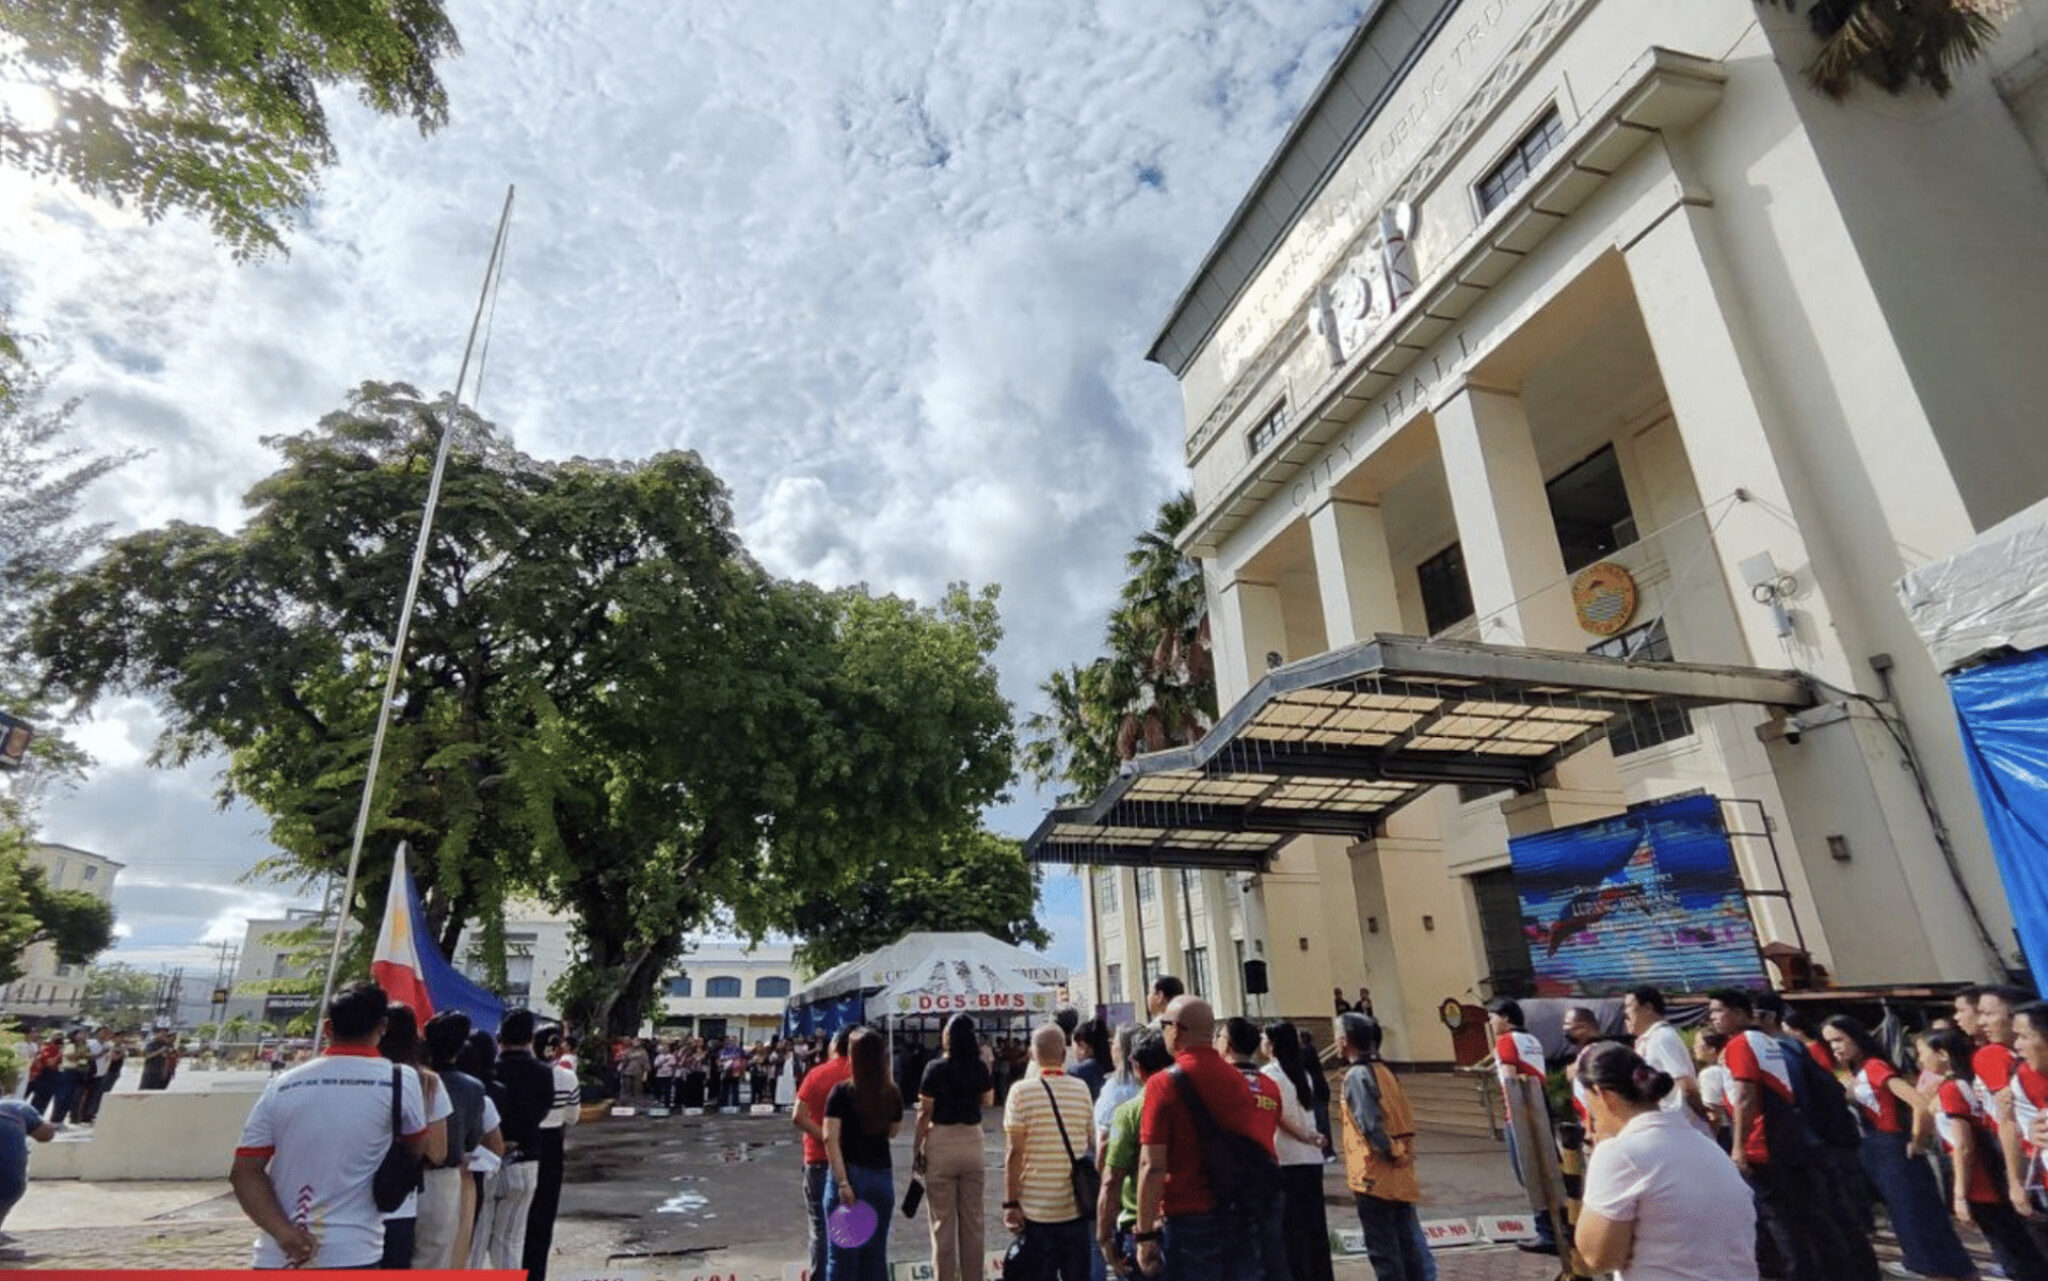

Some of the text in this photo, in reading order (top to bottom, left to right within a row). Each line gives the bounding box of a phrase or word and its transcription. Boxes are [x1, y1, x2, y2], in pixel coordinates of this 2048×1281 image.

[1368, 63, 1448, 178] PUBLIC
[1450, 0, 1510, 68] TRU
[1292, 332, 1479, 508] CITY HALL
